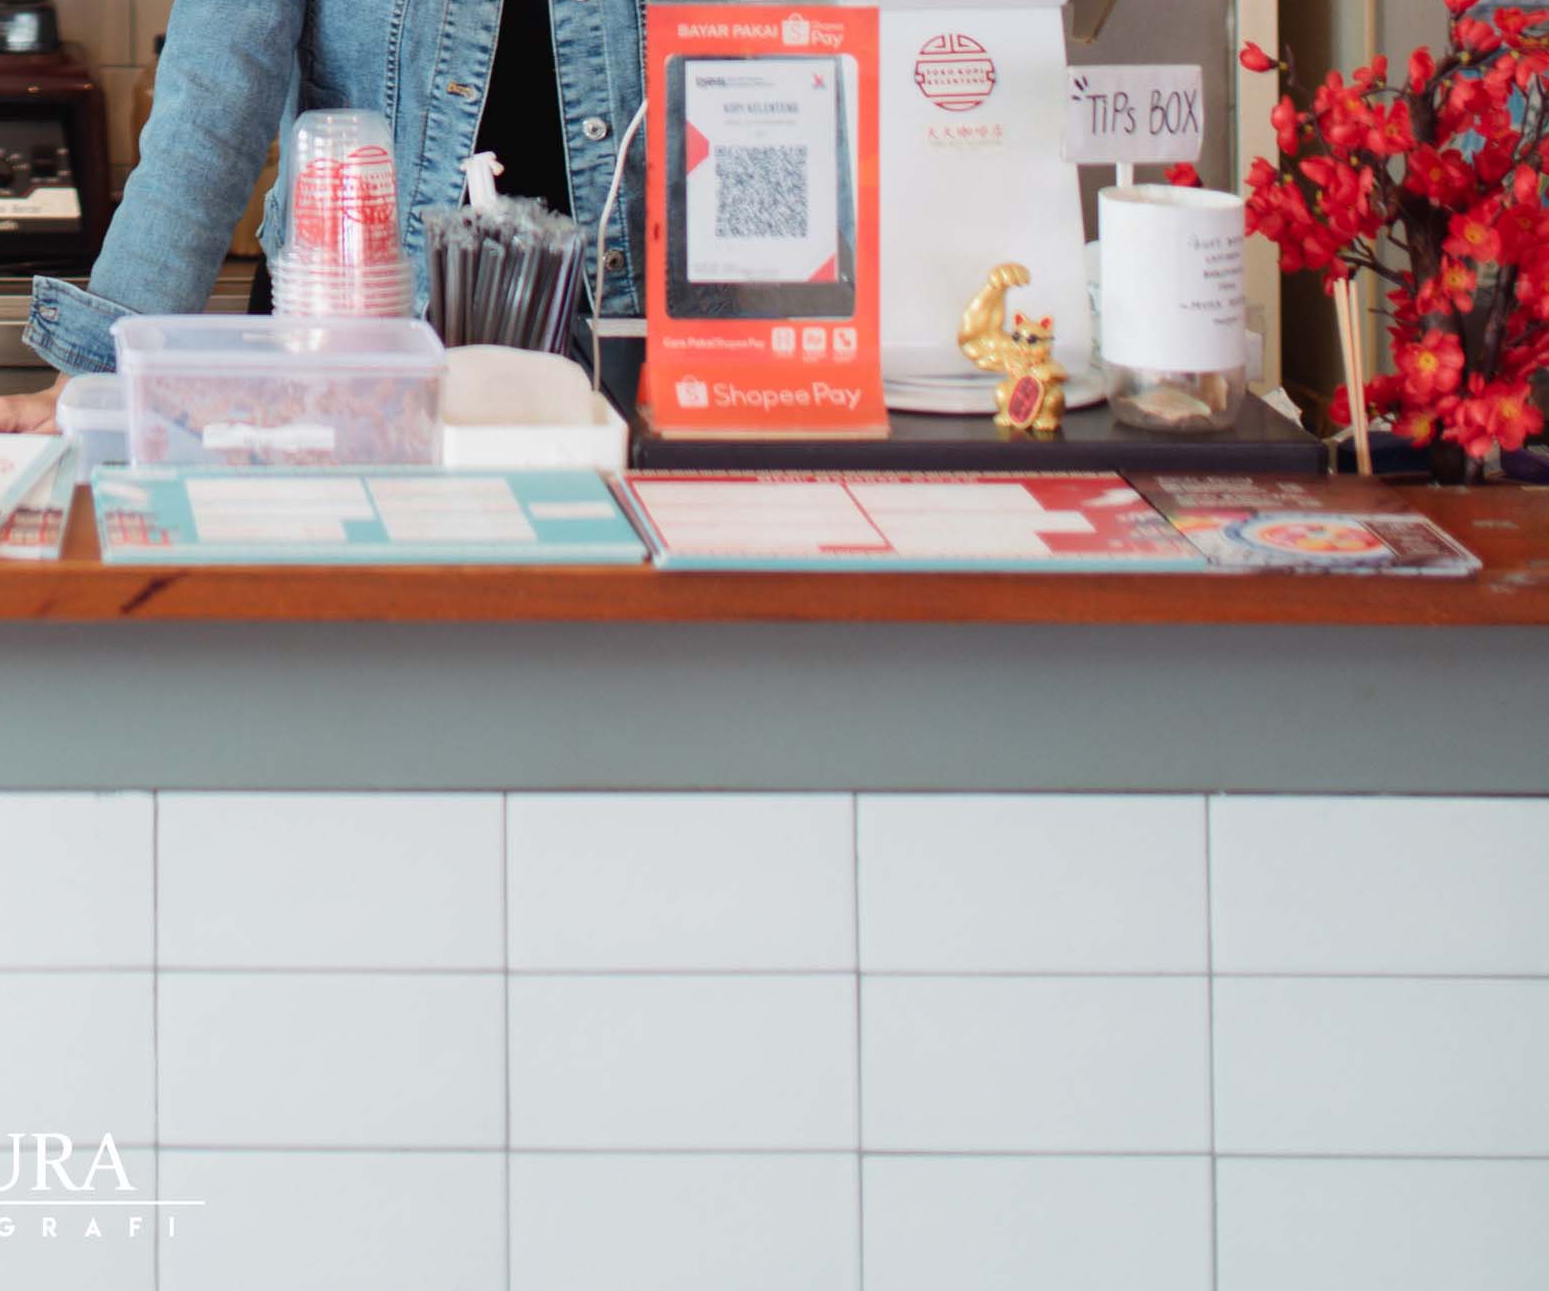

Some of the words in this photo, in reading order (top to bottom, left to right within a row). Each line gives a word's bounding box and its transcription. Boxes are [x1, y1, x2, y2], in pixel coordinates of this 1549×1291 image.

[677, 24, 729, 38] BAYAR
[732, 24, 778, 38] PAKAI
[810, 30, 843, 48] Pay
[1149, 89, 1199, 135] BOX
